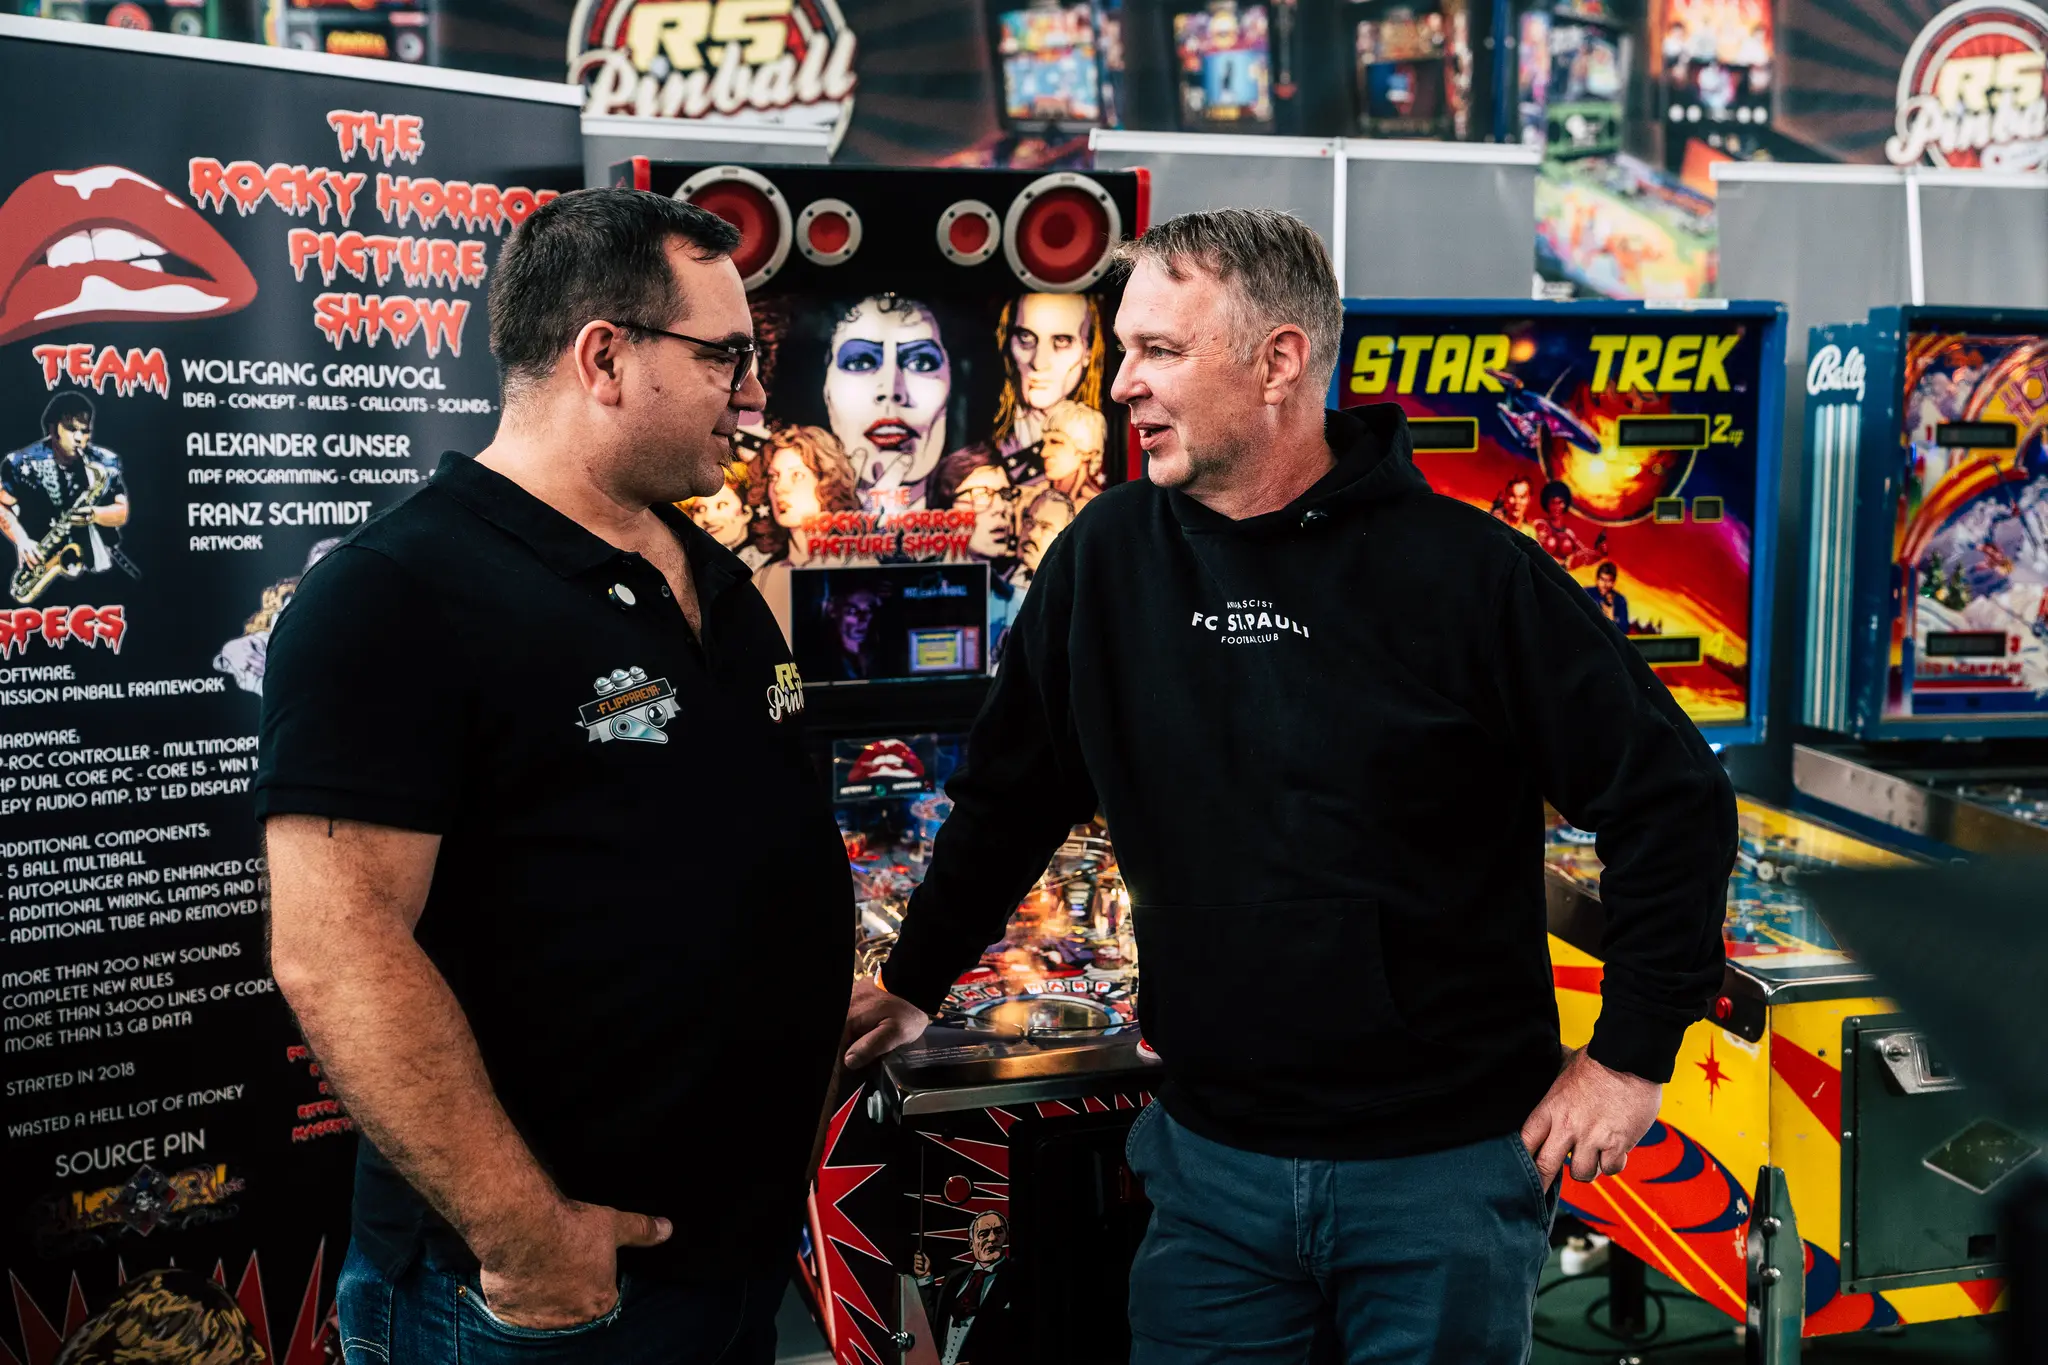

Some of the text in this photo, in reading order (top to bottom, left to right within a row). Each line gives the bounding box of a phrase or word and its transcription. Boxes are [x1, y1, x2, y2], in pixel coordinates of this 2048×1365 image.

[628, 0, 792, 72] RS
[568, 27, 857, 119] Pinball
[1938, 52, 2046, 114] RS
[326, 109, 424, 167] THE
[188, 156, 561, 235] ROCKY HORRO
[287, 228, 488, 289] PICTURE
[314, 292, 470, 358] SHOW
[32, 343, 170, 399] TEAM
[181, 359, 446, 390] WOLFGANG GRAUVOGL
[1350, 334, 1739, 394] STAR TREK
[1806, 344, 1866, 401] Bally
[183, 392, 215, 408] IDEA
[228, 393, 296, 410] CONCEPT
[307, 395, 349, 411] RULES
[359, 396, 428, 413] CALLOUTS
[437, 398, 491, 414] SOUNDS
[186, 432, 411, 458] ALEXANDER GUNSER
[188, 468, 222, 484] MPF
[225, 469, 338, 484] PROGRAMMING
[349, 469, 419, 484] CALLOUTS
[187, 501, 372, 527] FRANZ SCHMIDT
[801, 509, 976, 533] ROCKY HORROR
[189, 534, 263, 551] ARTWORK
[808, 533, 971, 558] PICTURE SHOW
[1191, 611, 1219, 631] FC
[62, 683, 125, 702] PINBALL
[128, 677, 226, 698] FRAMEWORK
[0, 728, 81, 749] ARDWARE:
[48, 744, 150, 766] CONTROLLER
[21, 773, 62, 791] DUAL
[65, 767, 108, 788] CORE
[112, 766, 134, 783] PC
[147, 762, 189, 780] CORE
[218, 757, 249, 774] WIN
[0, 798, 32, 815] EPY
[35, 792, 88, 812] AUDIO
[161, 783, 188, 800] LED
[190, 777, 251, 798] DISPLAY
[7, 850, 146, 880] 5 BALL MULTIBALL
[8, 873, 124, 901] AUTOPLUNGER
[127, 868, 160, 887] AND
[163, 859, 243, 884] ENHANCED
[9, 899, 104, 923] ADDITIONAL
[167, 883, 220, 904] LAMPS
[224, 879, 255, 897] AND
[10, 920, 104, 945] ADDITIONAL
[108, 912, 145, 932] TUBE
[149, 907, 182, 927] AND
[185, 899, 258, 922] REMOVED
[2, 941, 241, 989] MORE THAN 200 NEW SOUNDS
[3, 971, 174, 1010] COMPLETE NEW RULES
[4, 977, 275, 1032] MORE THAN 34000 LINES OF CODE
[4, 1031, 53, 1053] MORE
[59, 1025, 101, 1046] THAN
[127, 1017, 148, 1034] GB
[152, 1011, 193, 1030] DATA
[6, 1062, 136, 1097] STARTED IN 2018
[8, 1084, 245, 1139] WASTED A HELL LOT OF MONEY
[55, 1129, 206, 1178] SOURCE PIN
